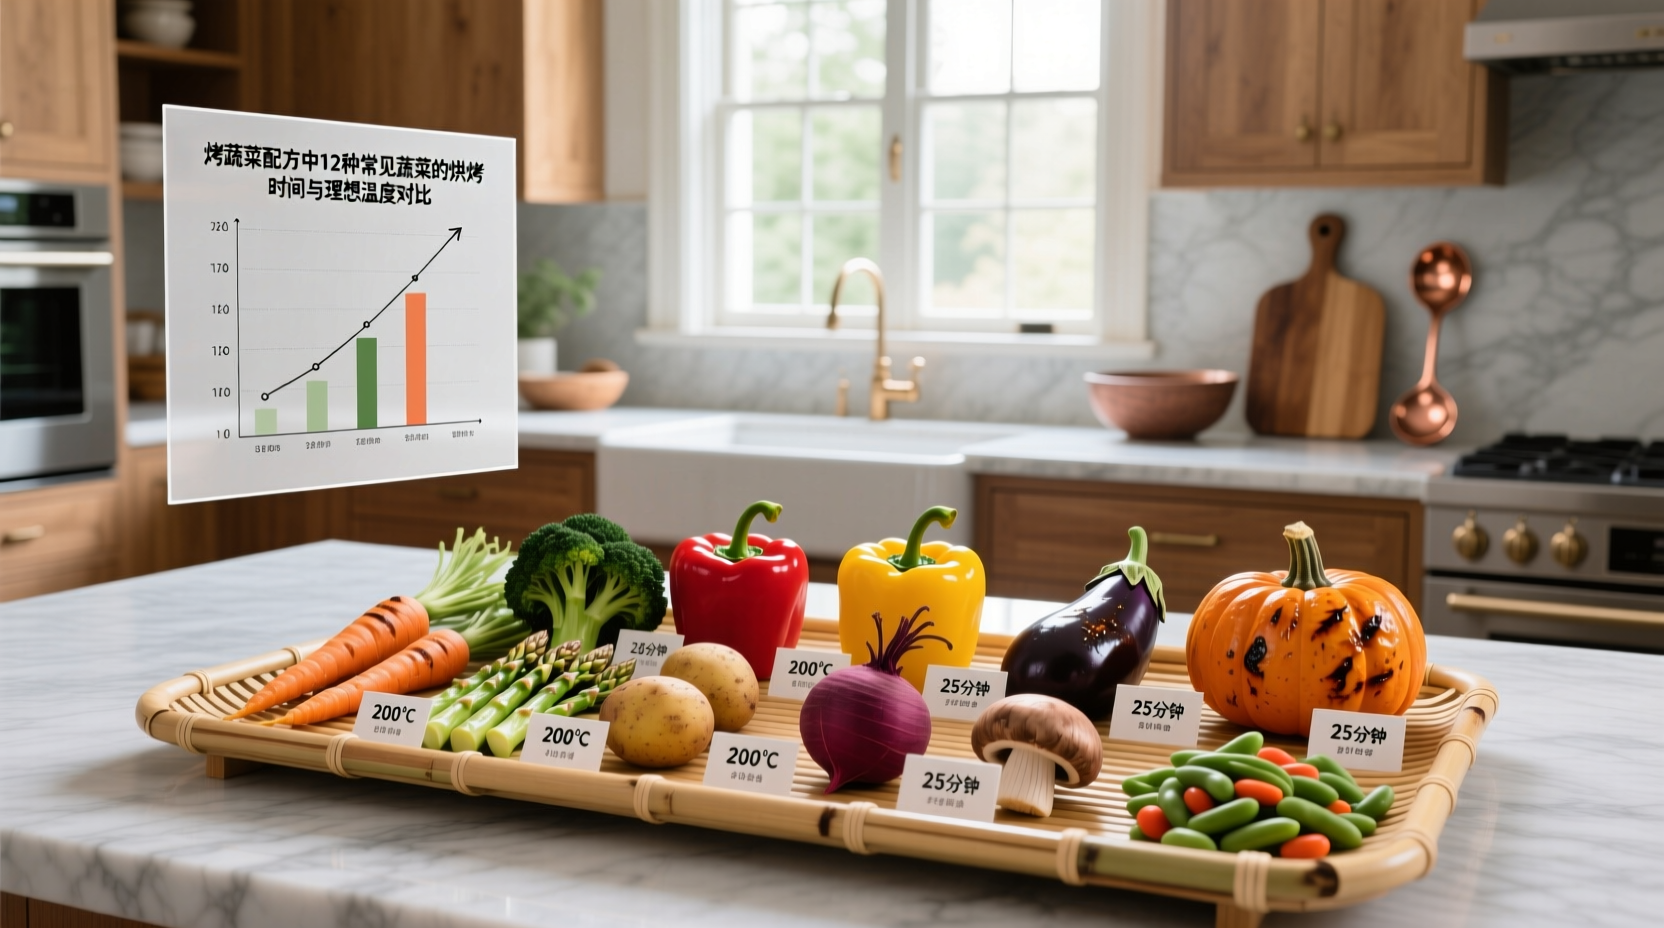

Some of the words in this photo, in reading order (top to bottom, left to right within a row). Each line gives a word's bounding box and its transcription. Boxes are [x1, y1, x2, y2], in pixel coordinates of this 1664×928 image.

[203, 141, 485, 184] 烤蔬菜配方中12种常见蔬菜的烘烤
[268, 176, 432, 206] 时间与理想温度对比
[940, 678, 991, 697] 25分钟
[1131, 699, 1185, 721] 25分钟
[1330, 723, 1387, 745] 25分钟
[922, 771, 980, 796] 25分钟
